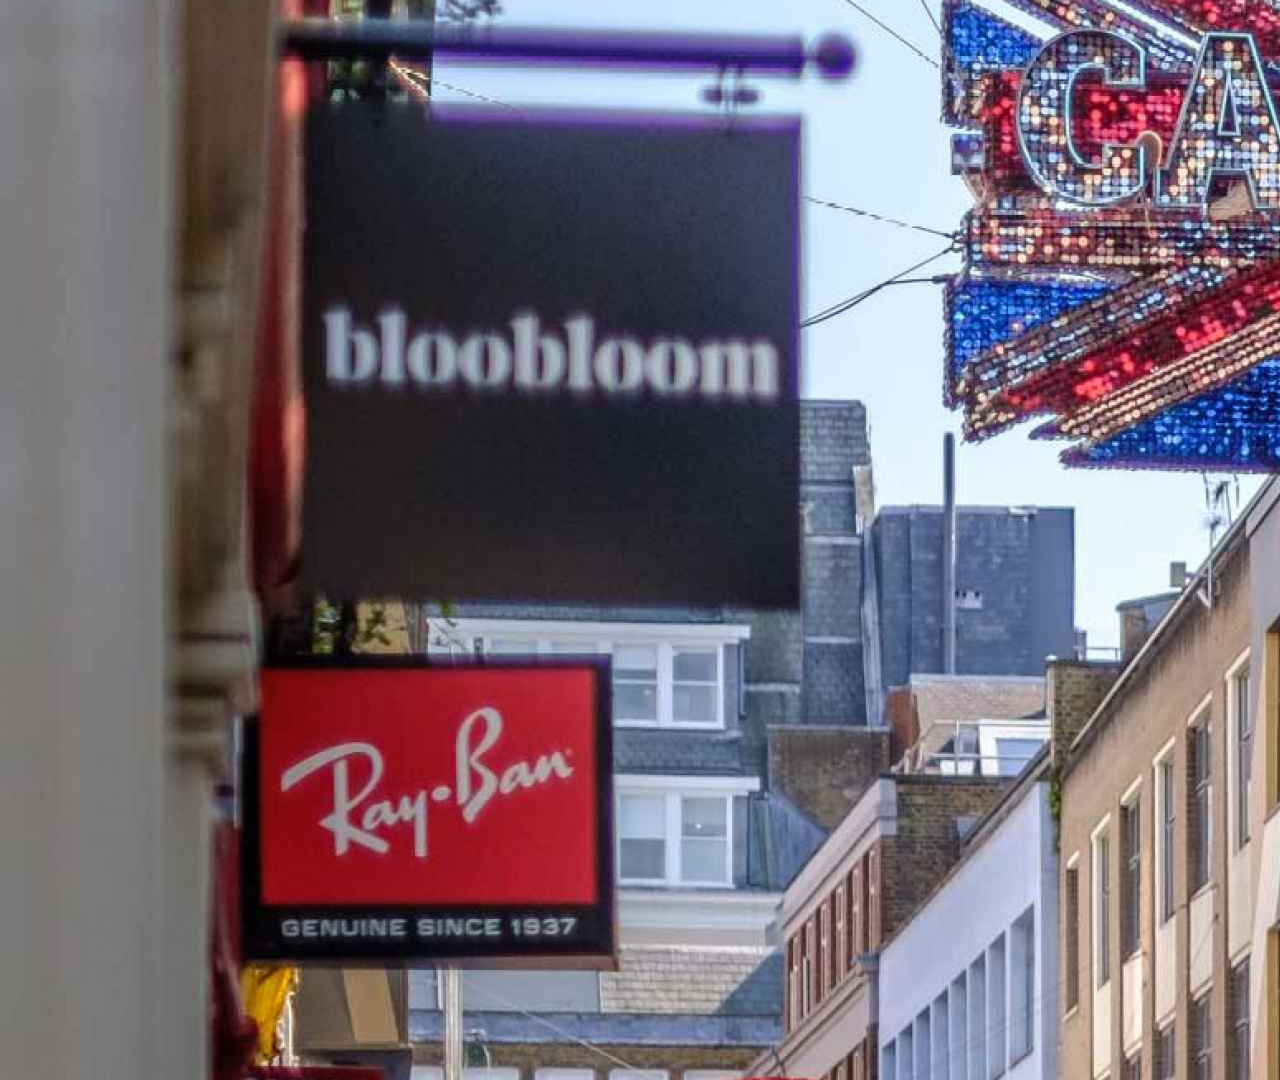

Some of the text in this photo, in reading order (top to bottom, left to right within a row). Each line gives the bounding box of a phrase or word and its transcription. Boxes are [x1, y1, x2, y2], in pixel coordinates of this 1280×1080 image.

[323, 305, 779, 399] bloobloom
[281, 917, 577, 937] GENUINE SINCE 1937
